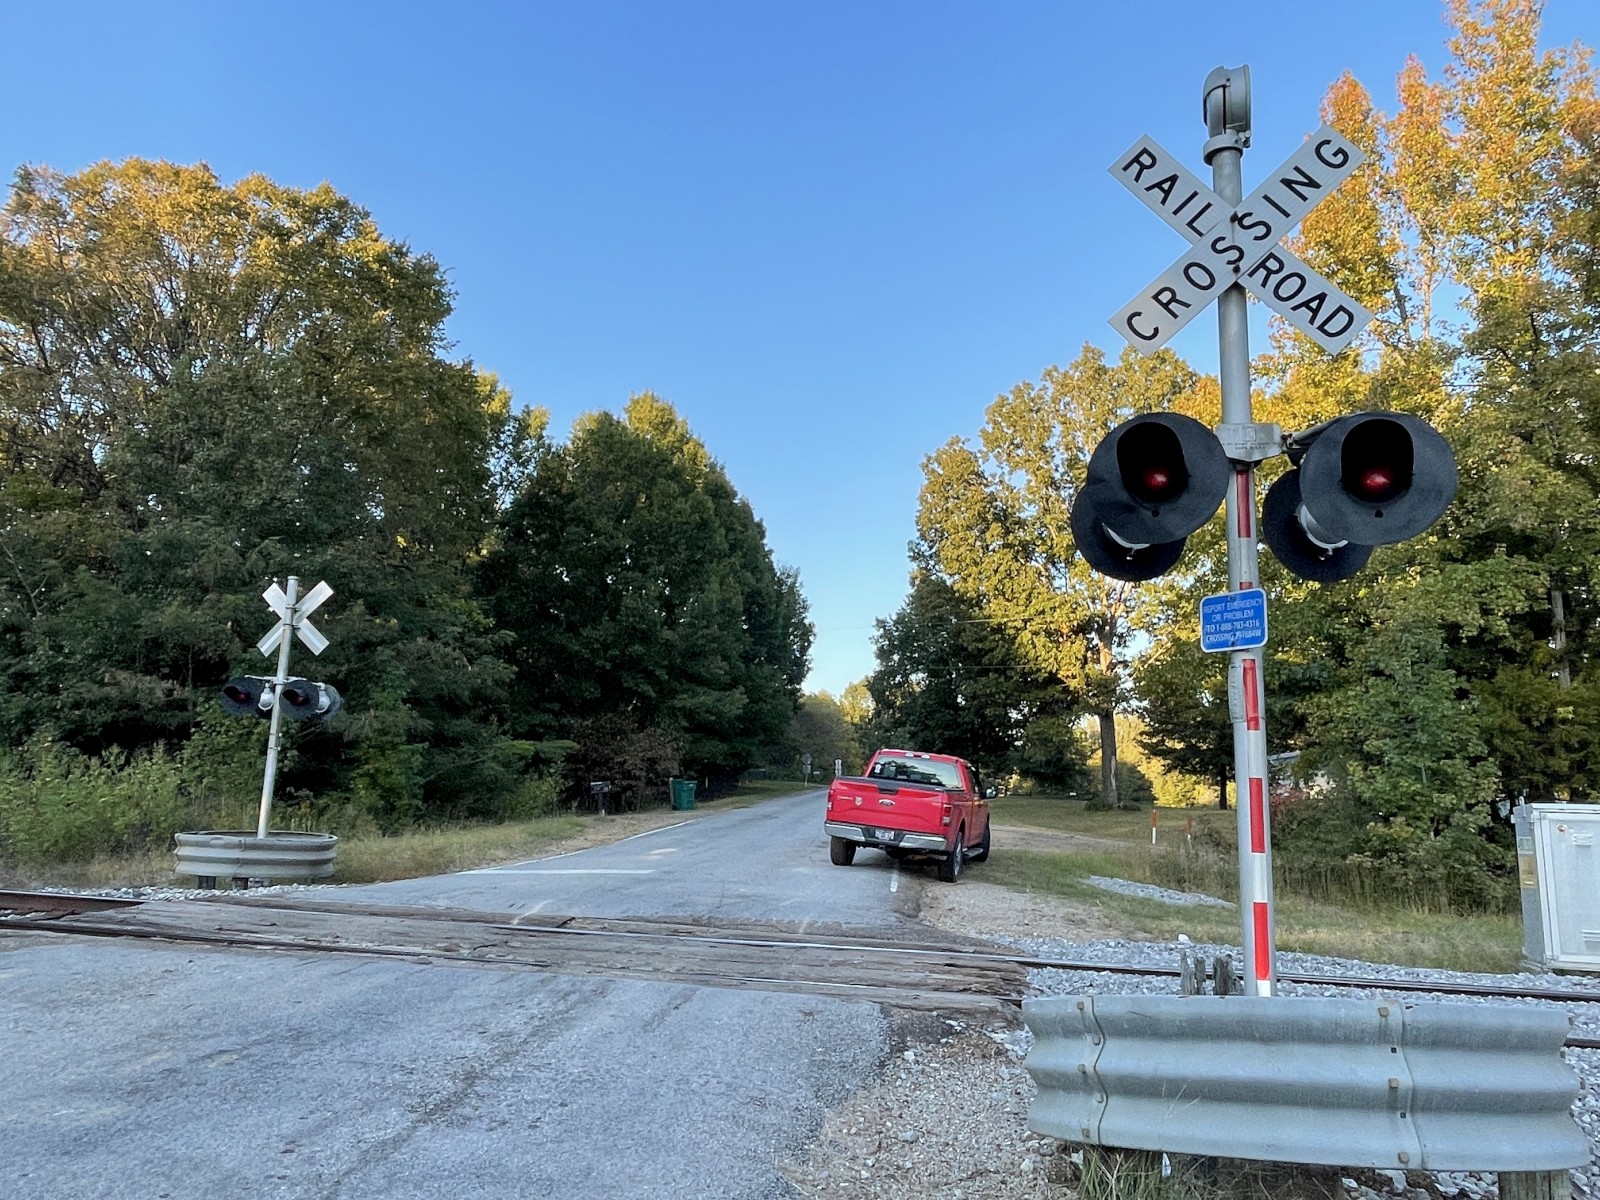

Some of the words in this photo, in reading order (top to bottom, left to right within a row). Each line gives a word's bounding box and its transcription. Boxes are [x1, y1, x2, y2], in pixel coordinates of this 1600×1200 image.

[1121, 147, 1213, 237] RAIL
[1246, 252, 1355, 338] ROAD
[1126, 138, 1350, 341] CROSSING
[1204, 603, 1225, 613] REPORT
[1227, 598, 1262, 610] EMERGENCY
[1212, 614, 1221, 622] OR
[1224, 609, 1254, 620] PROBLEM
[1206, 632, 1234, 643] CROSSING
